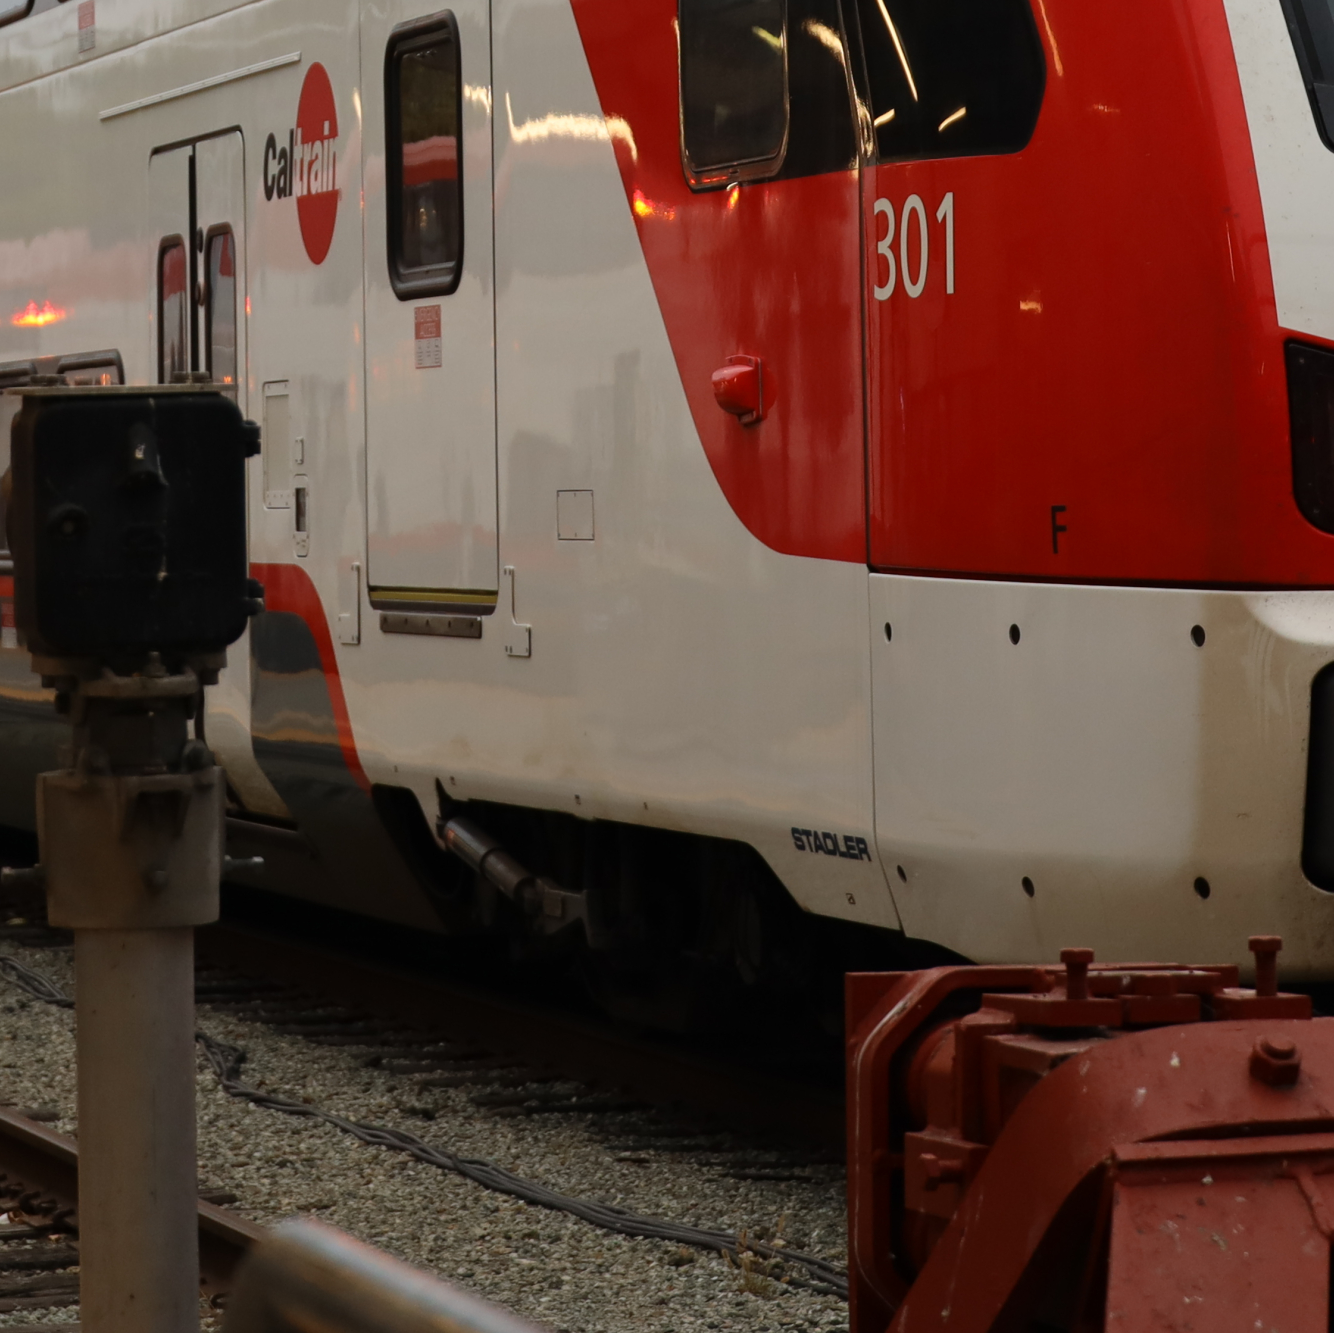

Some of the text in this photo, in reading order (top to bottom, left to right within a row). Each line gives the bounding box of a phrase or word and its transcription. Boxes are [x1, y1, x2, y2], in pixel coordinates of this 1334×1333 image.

[263, 120, 339, 202] Caltrain
[874, 192, 955, 301] 301
[1051, 505, 1067, 554] F
[791, 826, 872, 862] STADLER
